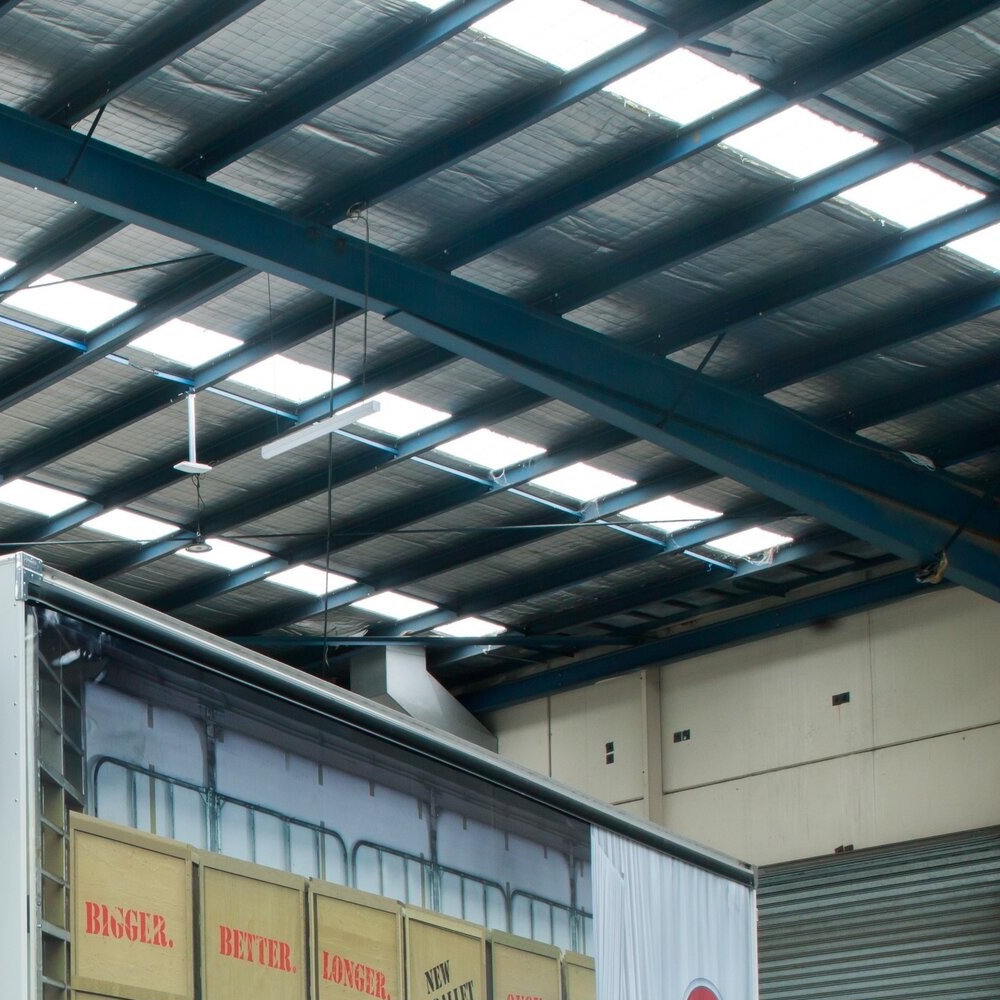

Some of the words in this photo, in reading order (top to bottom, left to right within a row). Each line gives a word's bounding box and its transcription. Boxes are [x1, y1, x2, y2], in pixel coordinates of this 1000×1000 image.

[85, 901, 174, 948] BIGGER.
[219, 925, 297, 974] BETTER.
[424, 959, 450, 995] NEW
